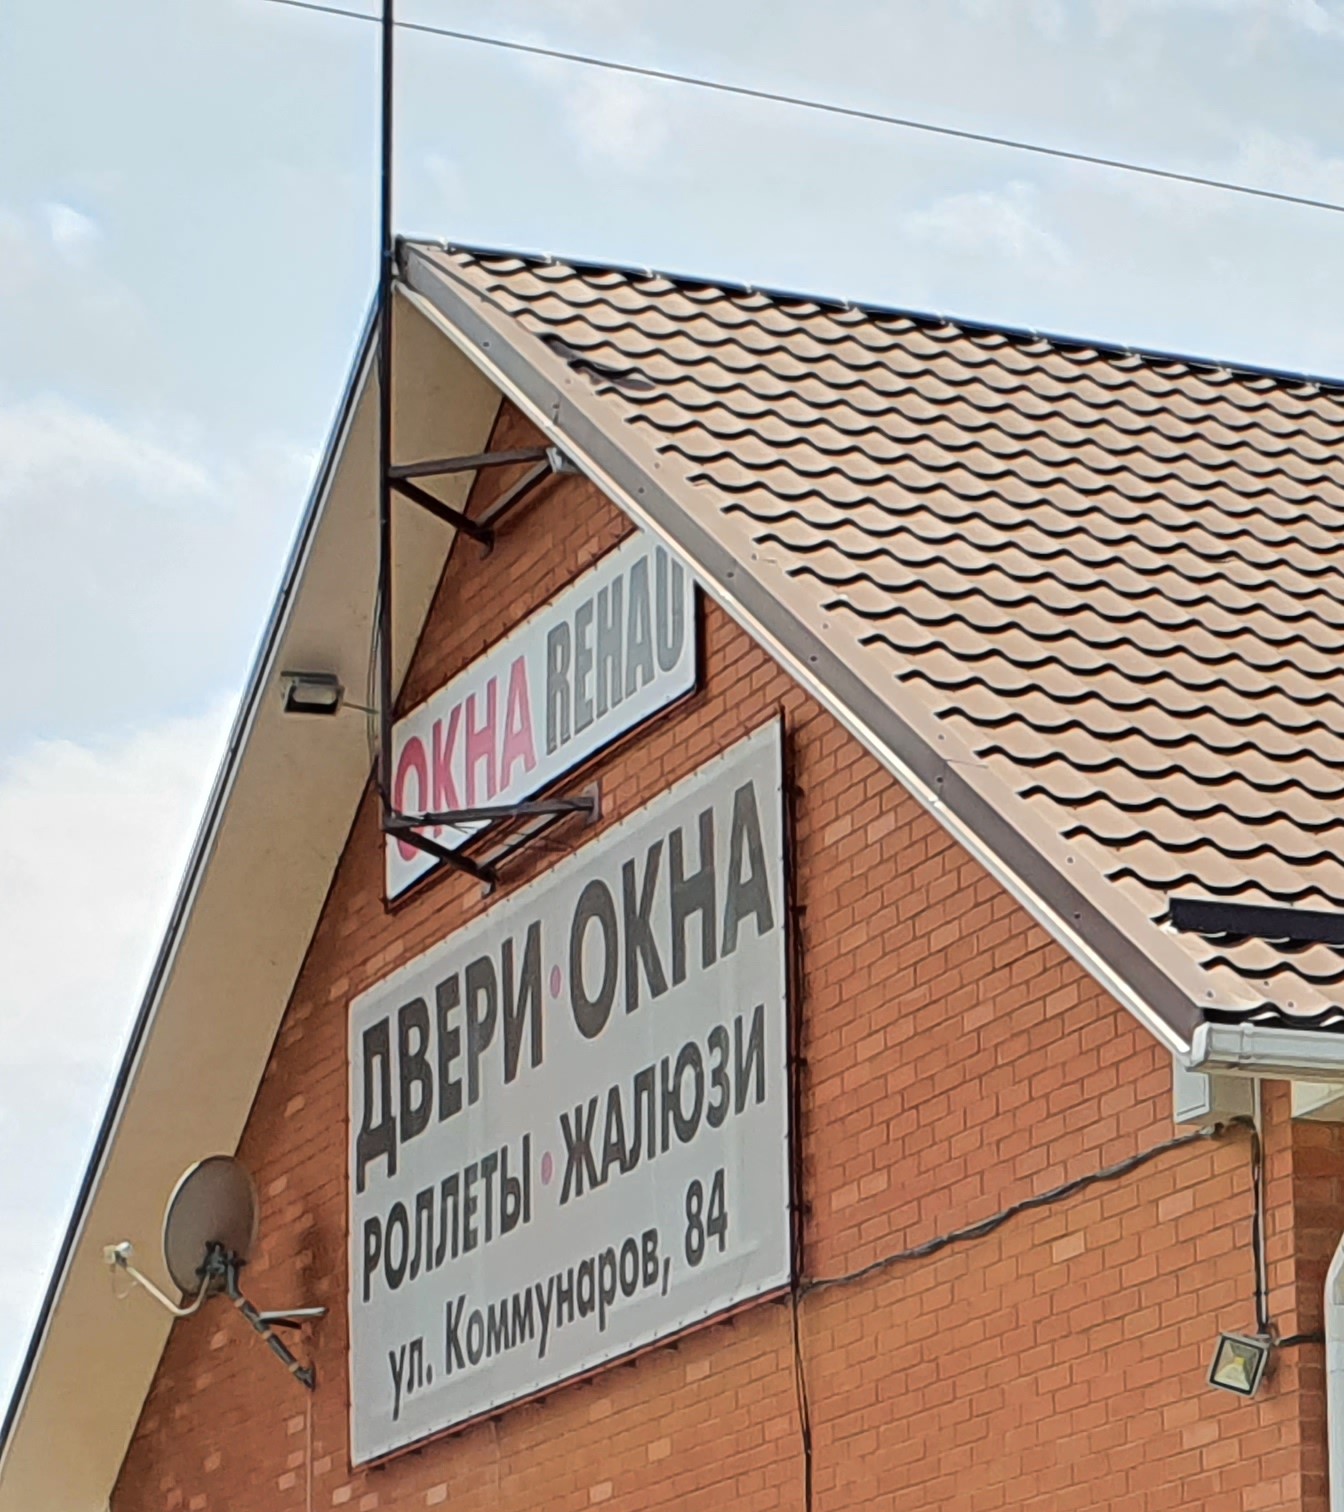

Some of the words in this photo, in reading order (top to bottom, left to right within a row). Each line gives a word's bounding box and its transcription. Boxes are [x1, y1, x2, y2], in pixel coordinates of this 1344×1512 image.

[395, 655, 537, 861] ОКНА
[547, 545, 685, 756] REHAU
[356, 920, 543, 1194] ДВЕРИ
[569, 780, 775, 1040] ОКНА
[363, 1133, 531, 1303] РОЛЛЕТЫ
[559, 1004, 766, 1206] ЖАЛЮЗИ
[389, 1337, 433, 1421] ул.
[446, 1228, 671, 1375] Коммунаров,
[684, 1168, 728, 1267] 84
